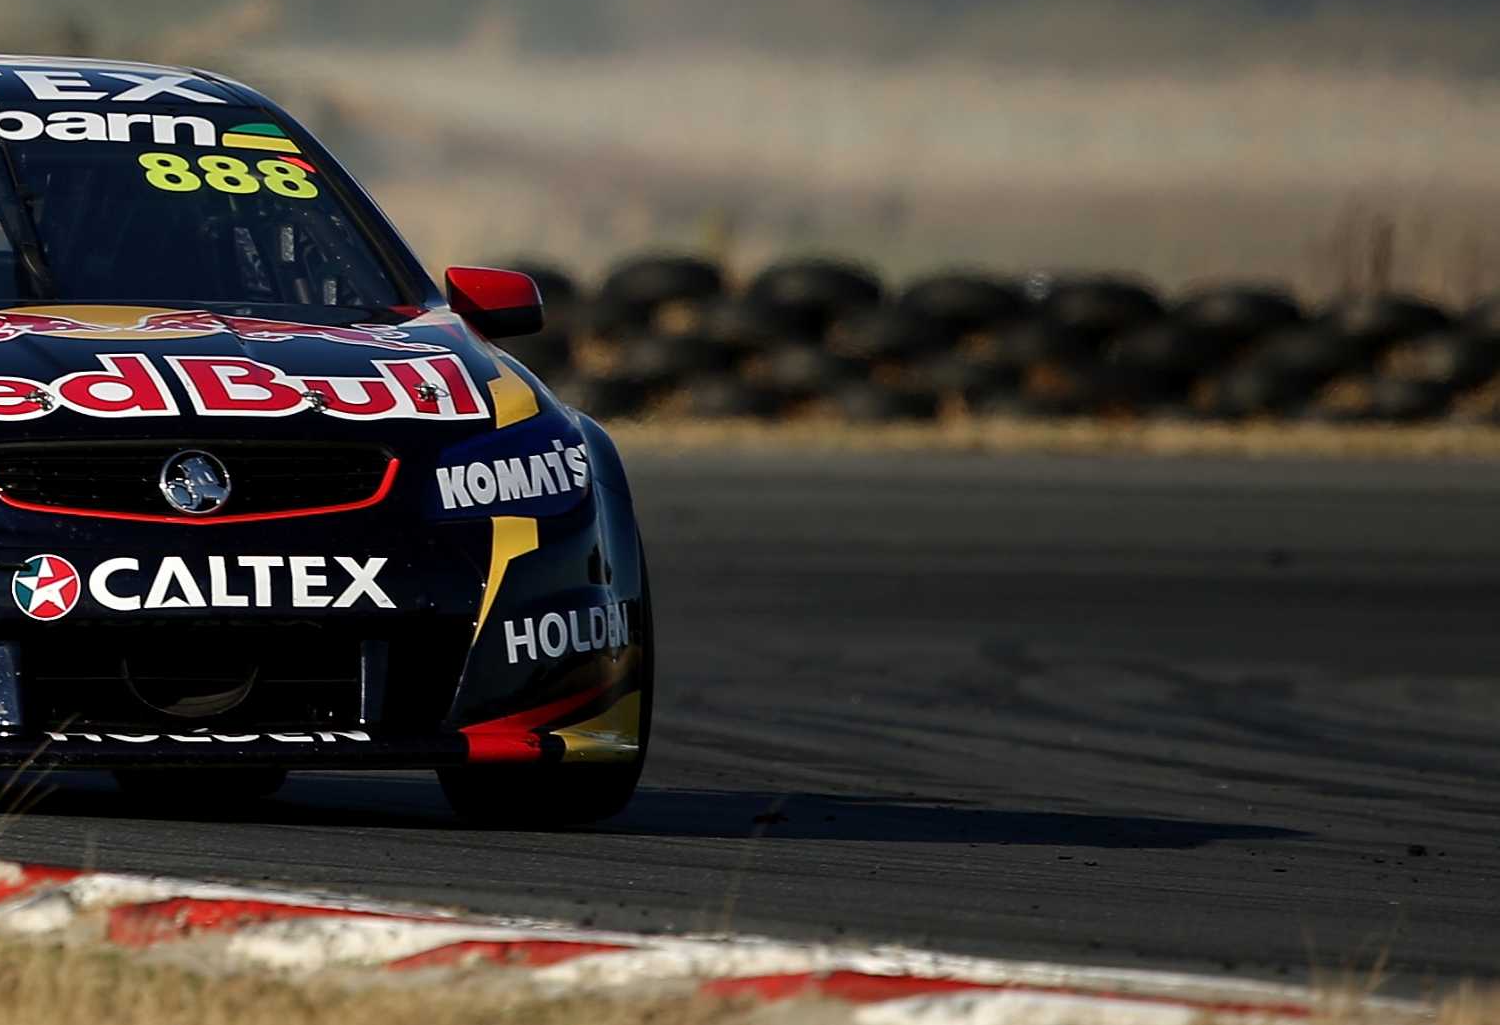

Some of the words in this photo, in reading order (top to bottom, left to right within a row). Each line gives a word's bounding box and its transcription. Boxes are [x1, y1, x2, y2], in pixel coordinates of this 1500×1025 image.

[138, 151, 319, 199] 888
[163, 353, 490, 421] Bull
[435, 439, 589, 510] KOMATS
[88, 555, 398, 611] CALTEX
[503, 602, 629, 665] HOLDEN
